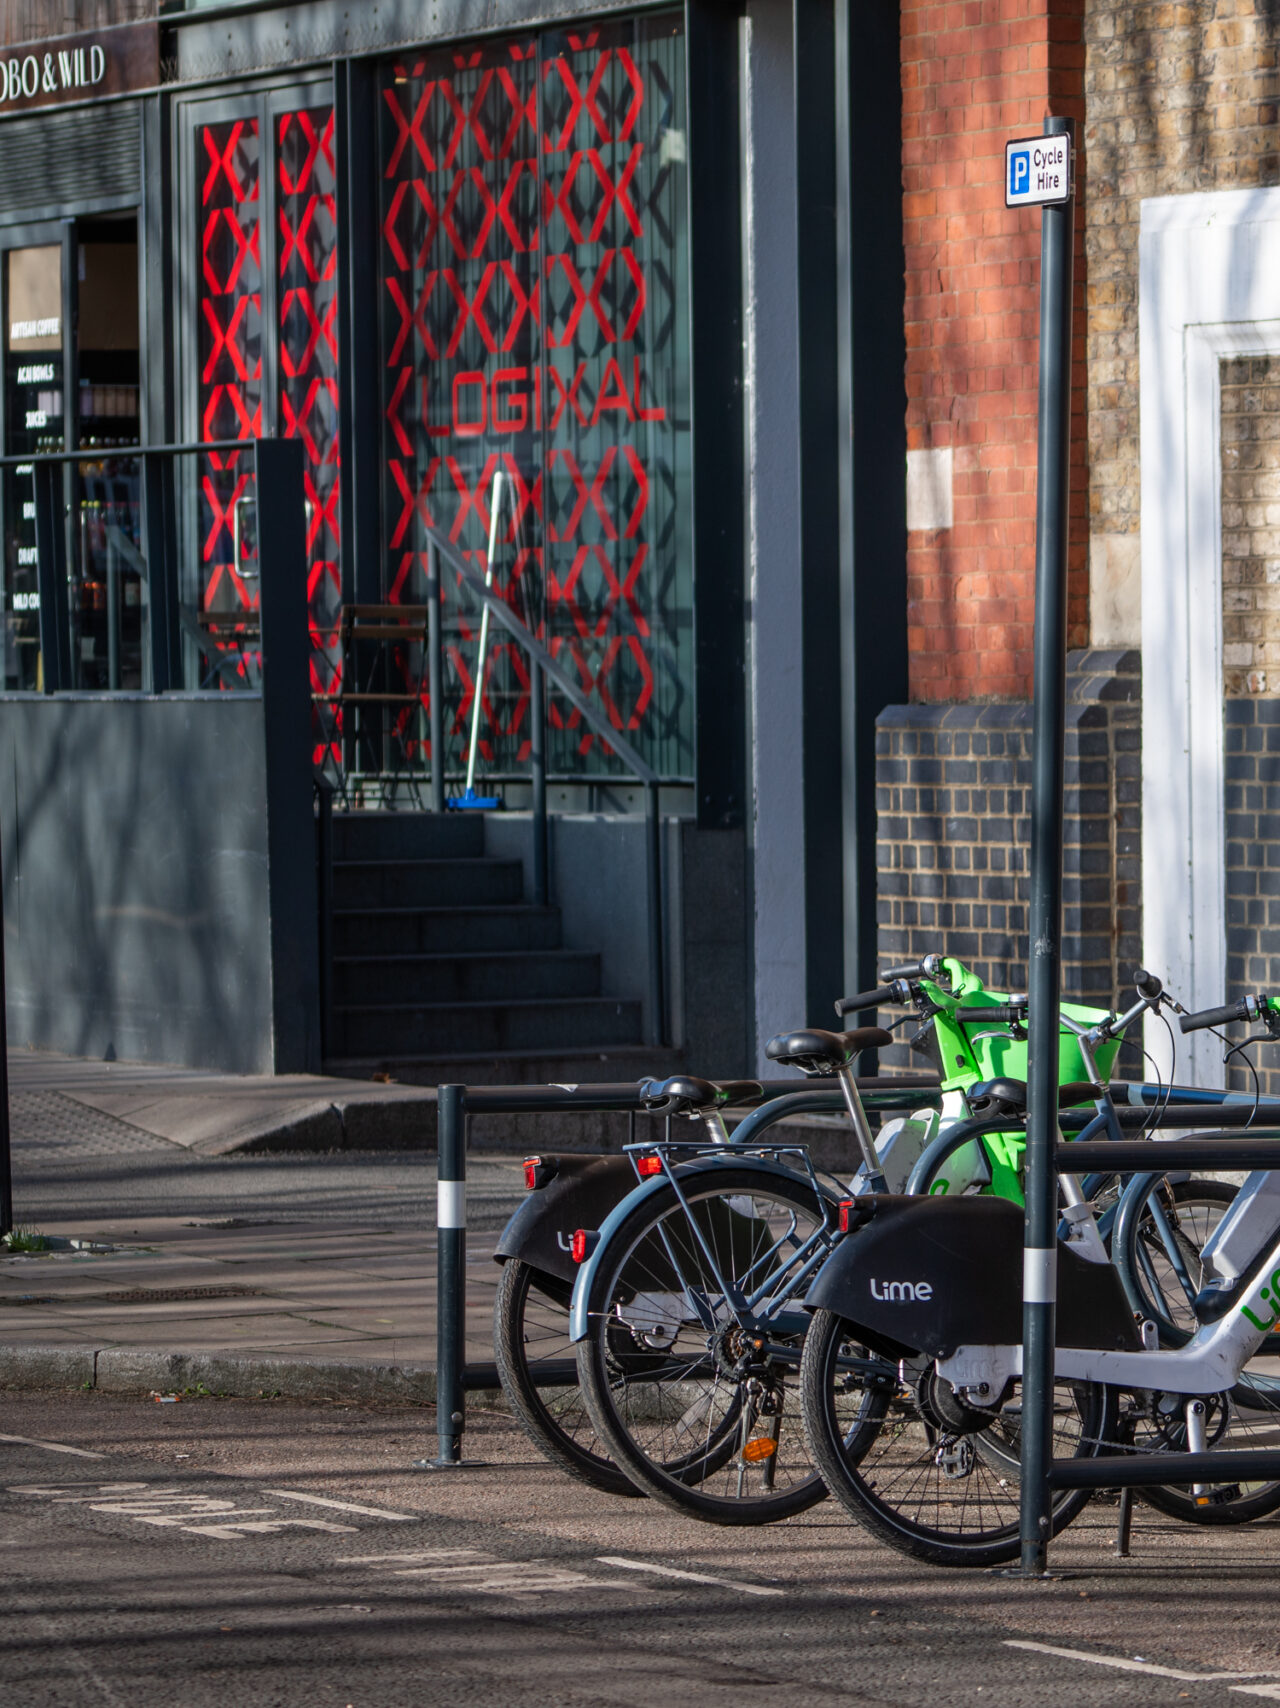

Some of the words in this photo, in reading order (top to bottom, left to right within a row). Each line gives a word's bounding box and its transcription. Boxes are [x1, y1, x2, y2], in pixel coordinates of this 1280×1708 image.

[58, 45, 105, 89] WILD
[1033, 146, 1063, 169] Cycle
[1037, 173, 1060, 190] Hire
[38, 317, 60, 336] COFFEE
[421, 355, 666, 438] LOGIXAL
[25, 410, 47, 429] JUICES
[557, 1231, 574, 1252] Li
[870, 1278, 934, 1301] Lime
[5, 1481, 360, 1540] CYCLE
